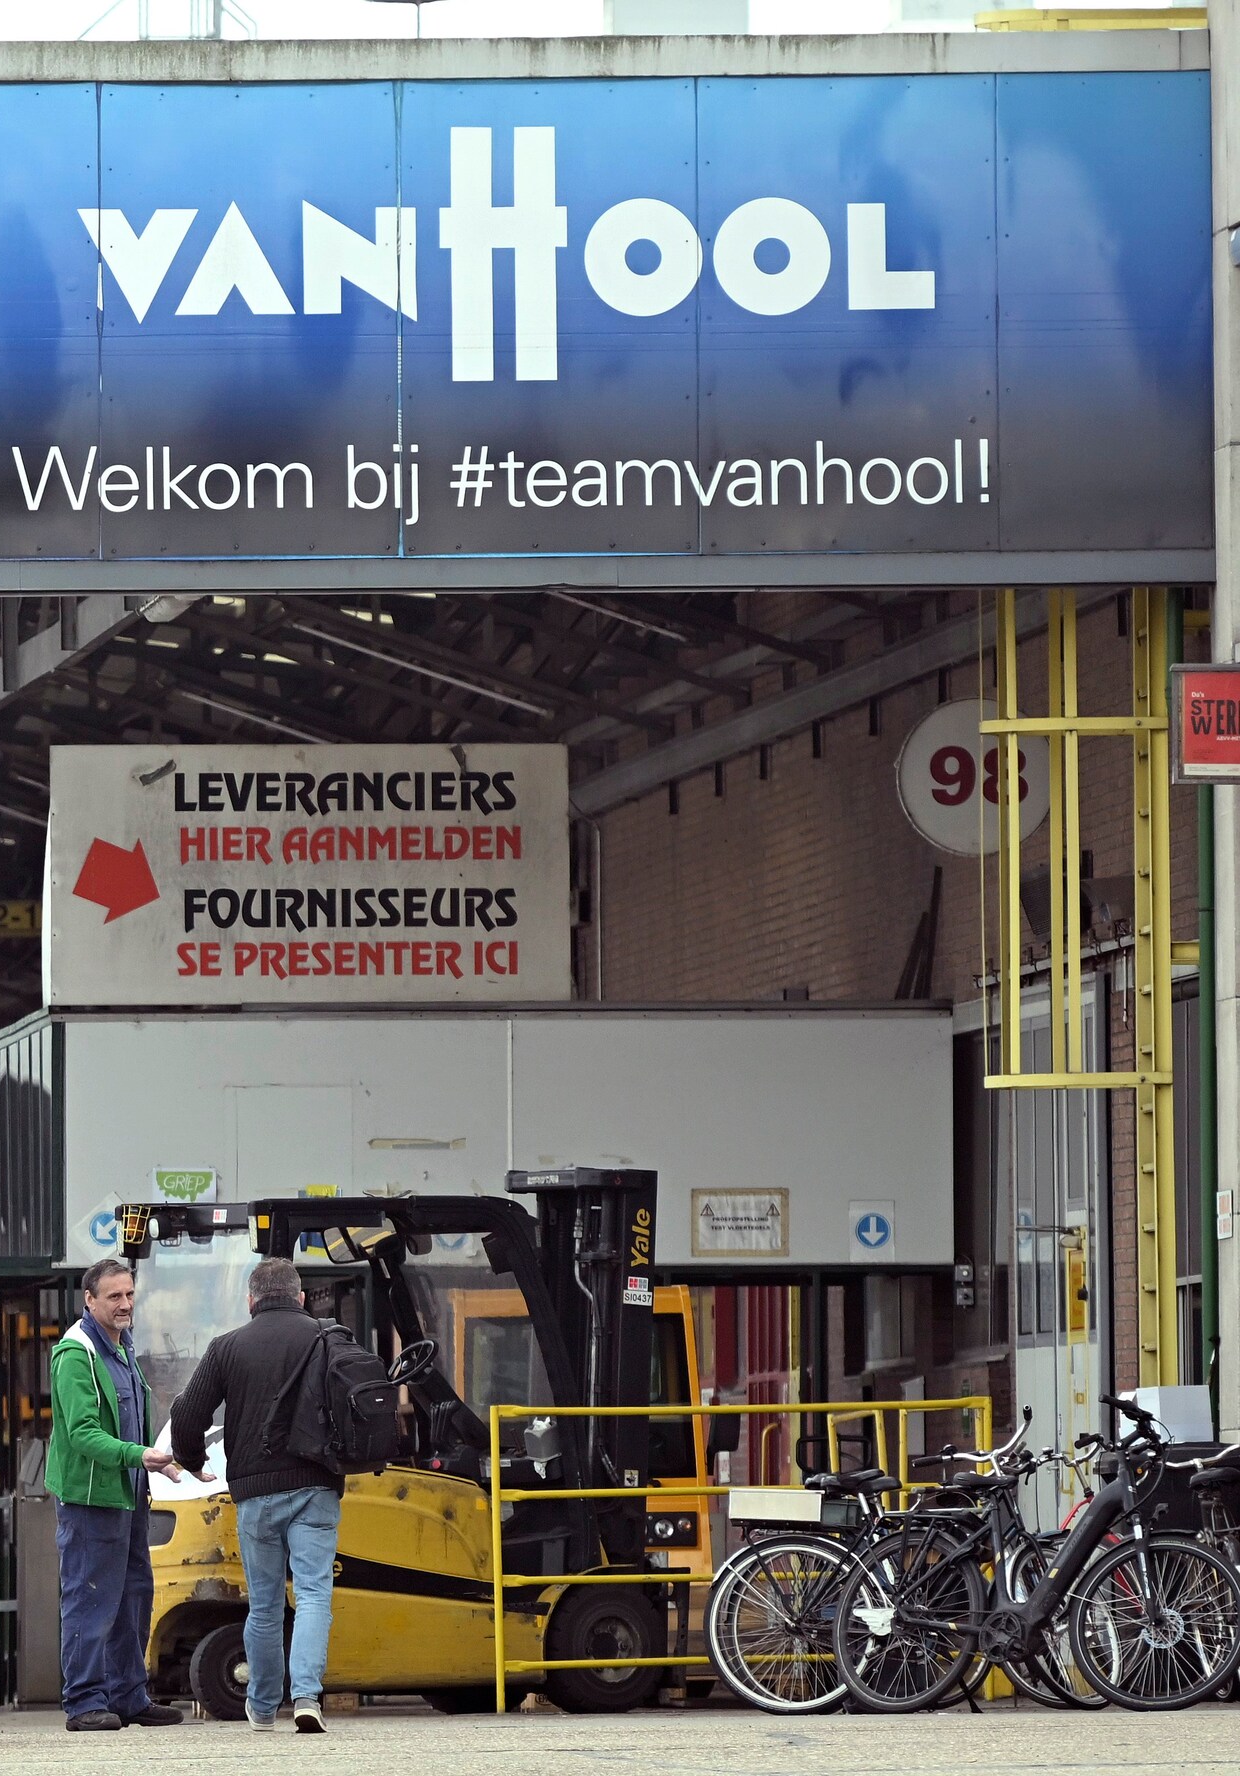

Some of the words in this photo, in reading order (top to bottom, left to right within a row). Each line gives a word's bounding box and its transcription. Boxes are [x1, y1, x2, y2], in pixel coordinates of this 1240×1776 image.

[12, 445, 314, 513] Welkom
[347, 445, 420, 526] bij
[450, 438, 992, 509] #teamvanhool!
[174, 771, 517, 817] LEVERANCIERS
[929, 745, 1029, 806] 98
[180, 826, 273, 865] HIER
[282, 826, 522, 865] AANMELDEN
[184, 888, 519, 933] FOURNISSEURS
[176, 941, 222, 977] SE
[233, 941, 464, 980] PRESENTER
[473, 941, 519, 976] ICI
[630, 1207, 652, 1268] Yale
